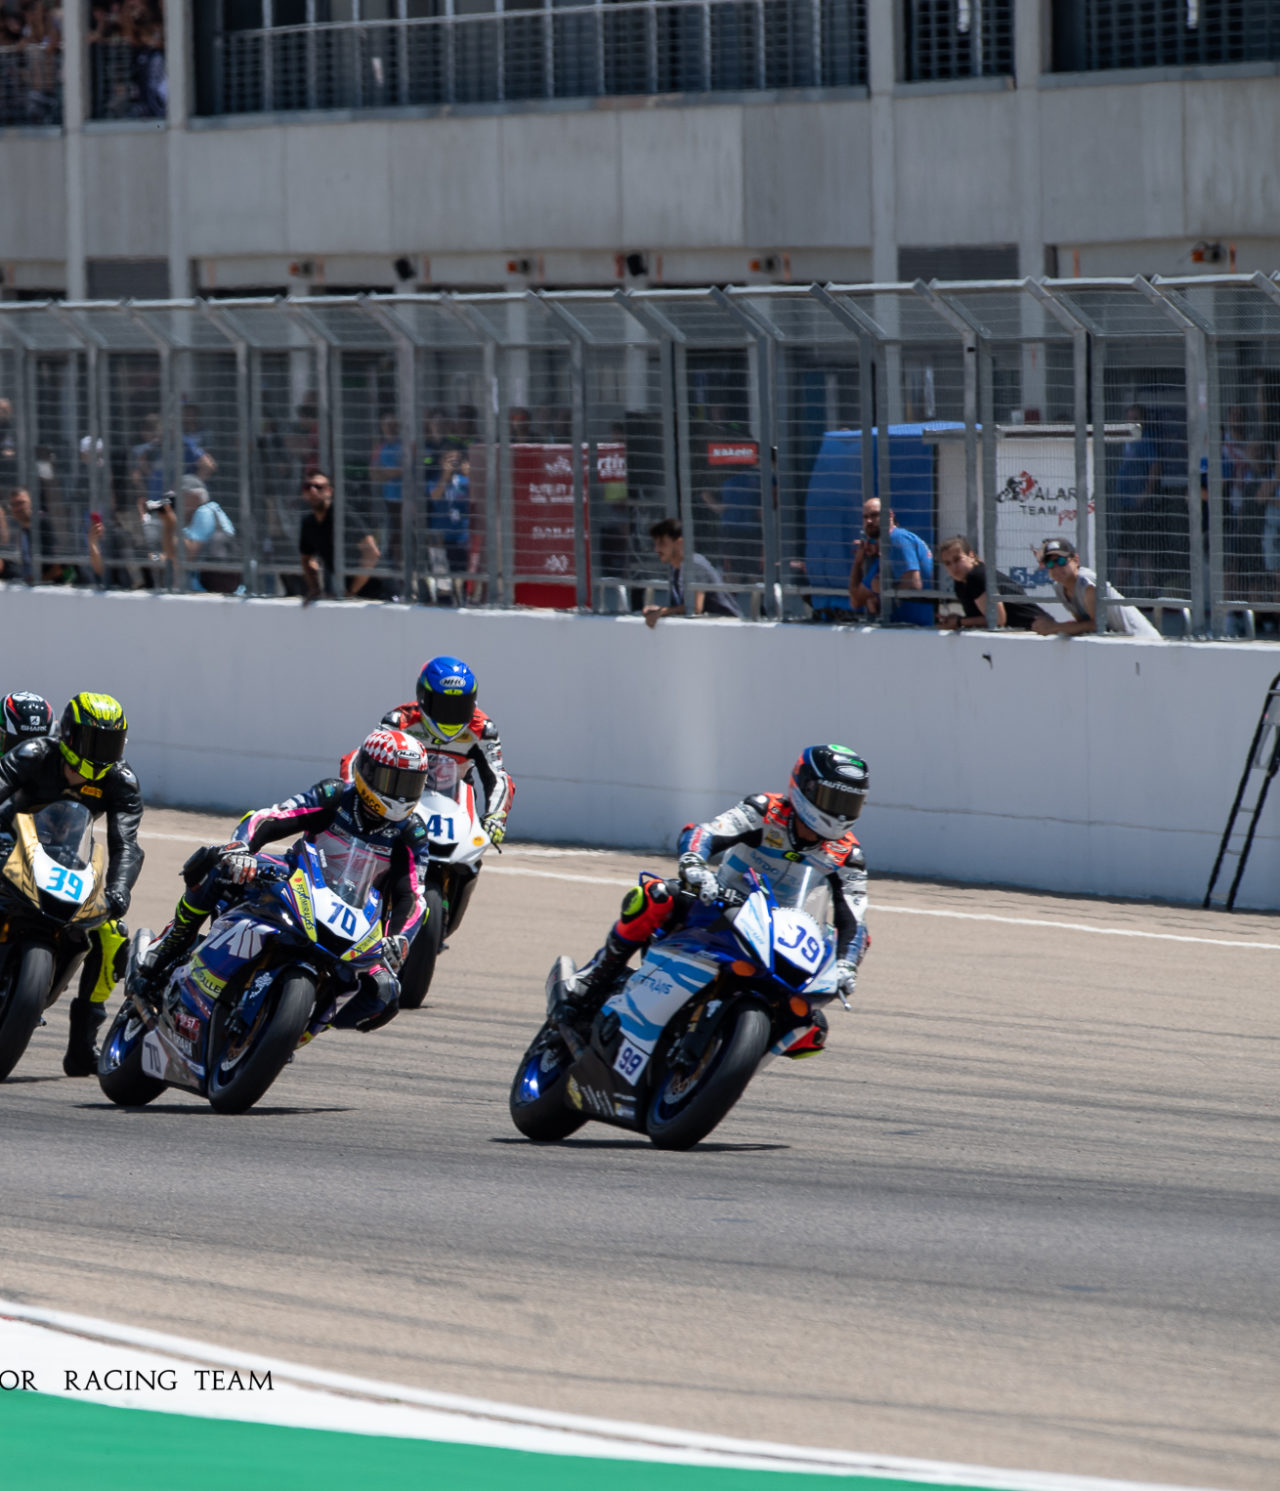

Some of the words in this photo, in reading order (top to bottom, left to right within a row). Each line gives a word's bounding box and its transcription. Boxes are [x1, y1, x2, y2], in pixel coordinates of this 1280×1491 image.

[1019, 505, 1057, 515] TEAM
[427, 814, 454, 840] 41
[46, 867, 84, 901] 39
[327, 902, 357, 937] 70
[620, 1047, 643, 1076] 99
